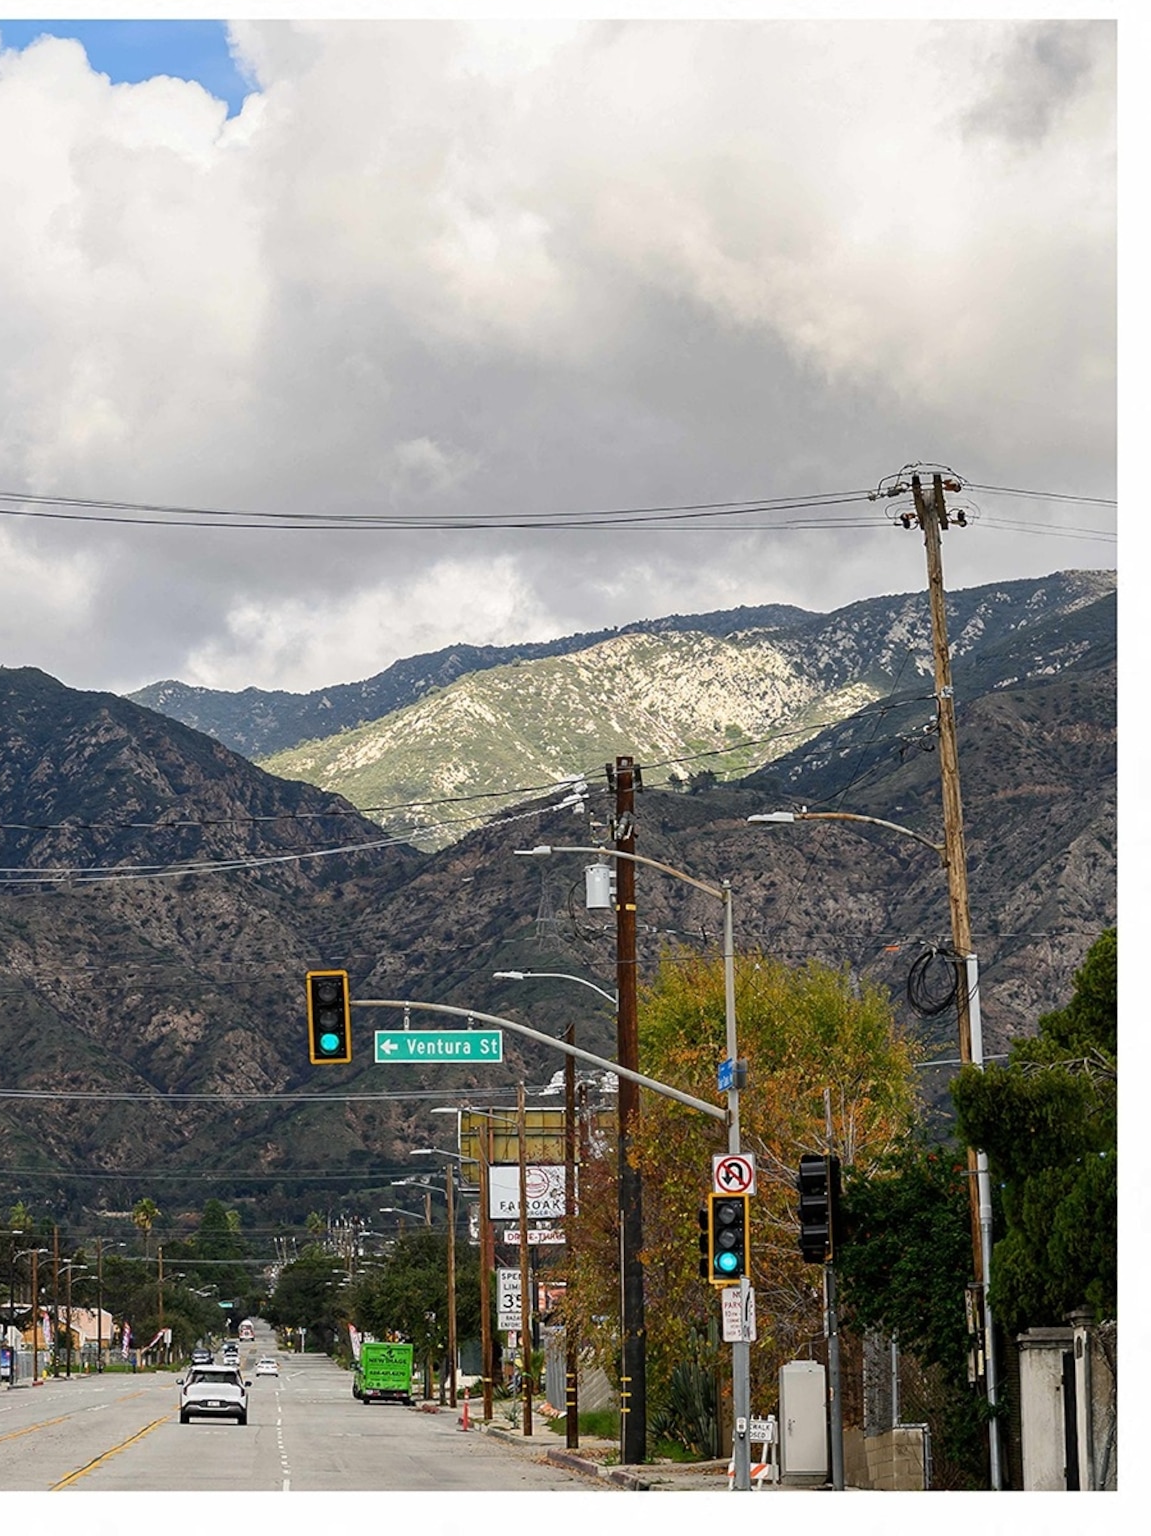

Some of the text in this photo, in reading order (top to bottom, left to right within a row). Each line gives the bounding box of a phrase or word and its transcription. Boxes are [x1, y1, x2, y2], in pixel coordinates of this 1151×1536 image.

[406, 1038, 498, 1055] Ventura St
[500, 1200, 565, 1212] FAIOAK
[501, 1273, 522, 1281] SPE
[503, 1294, 522, 1308] 35
